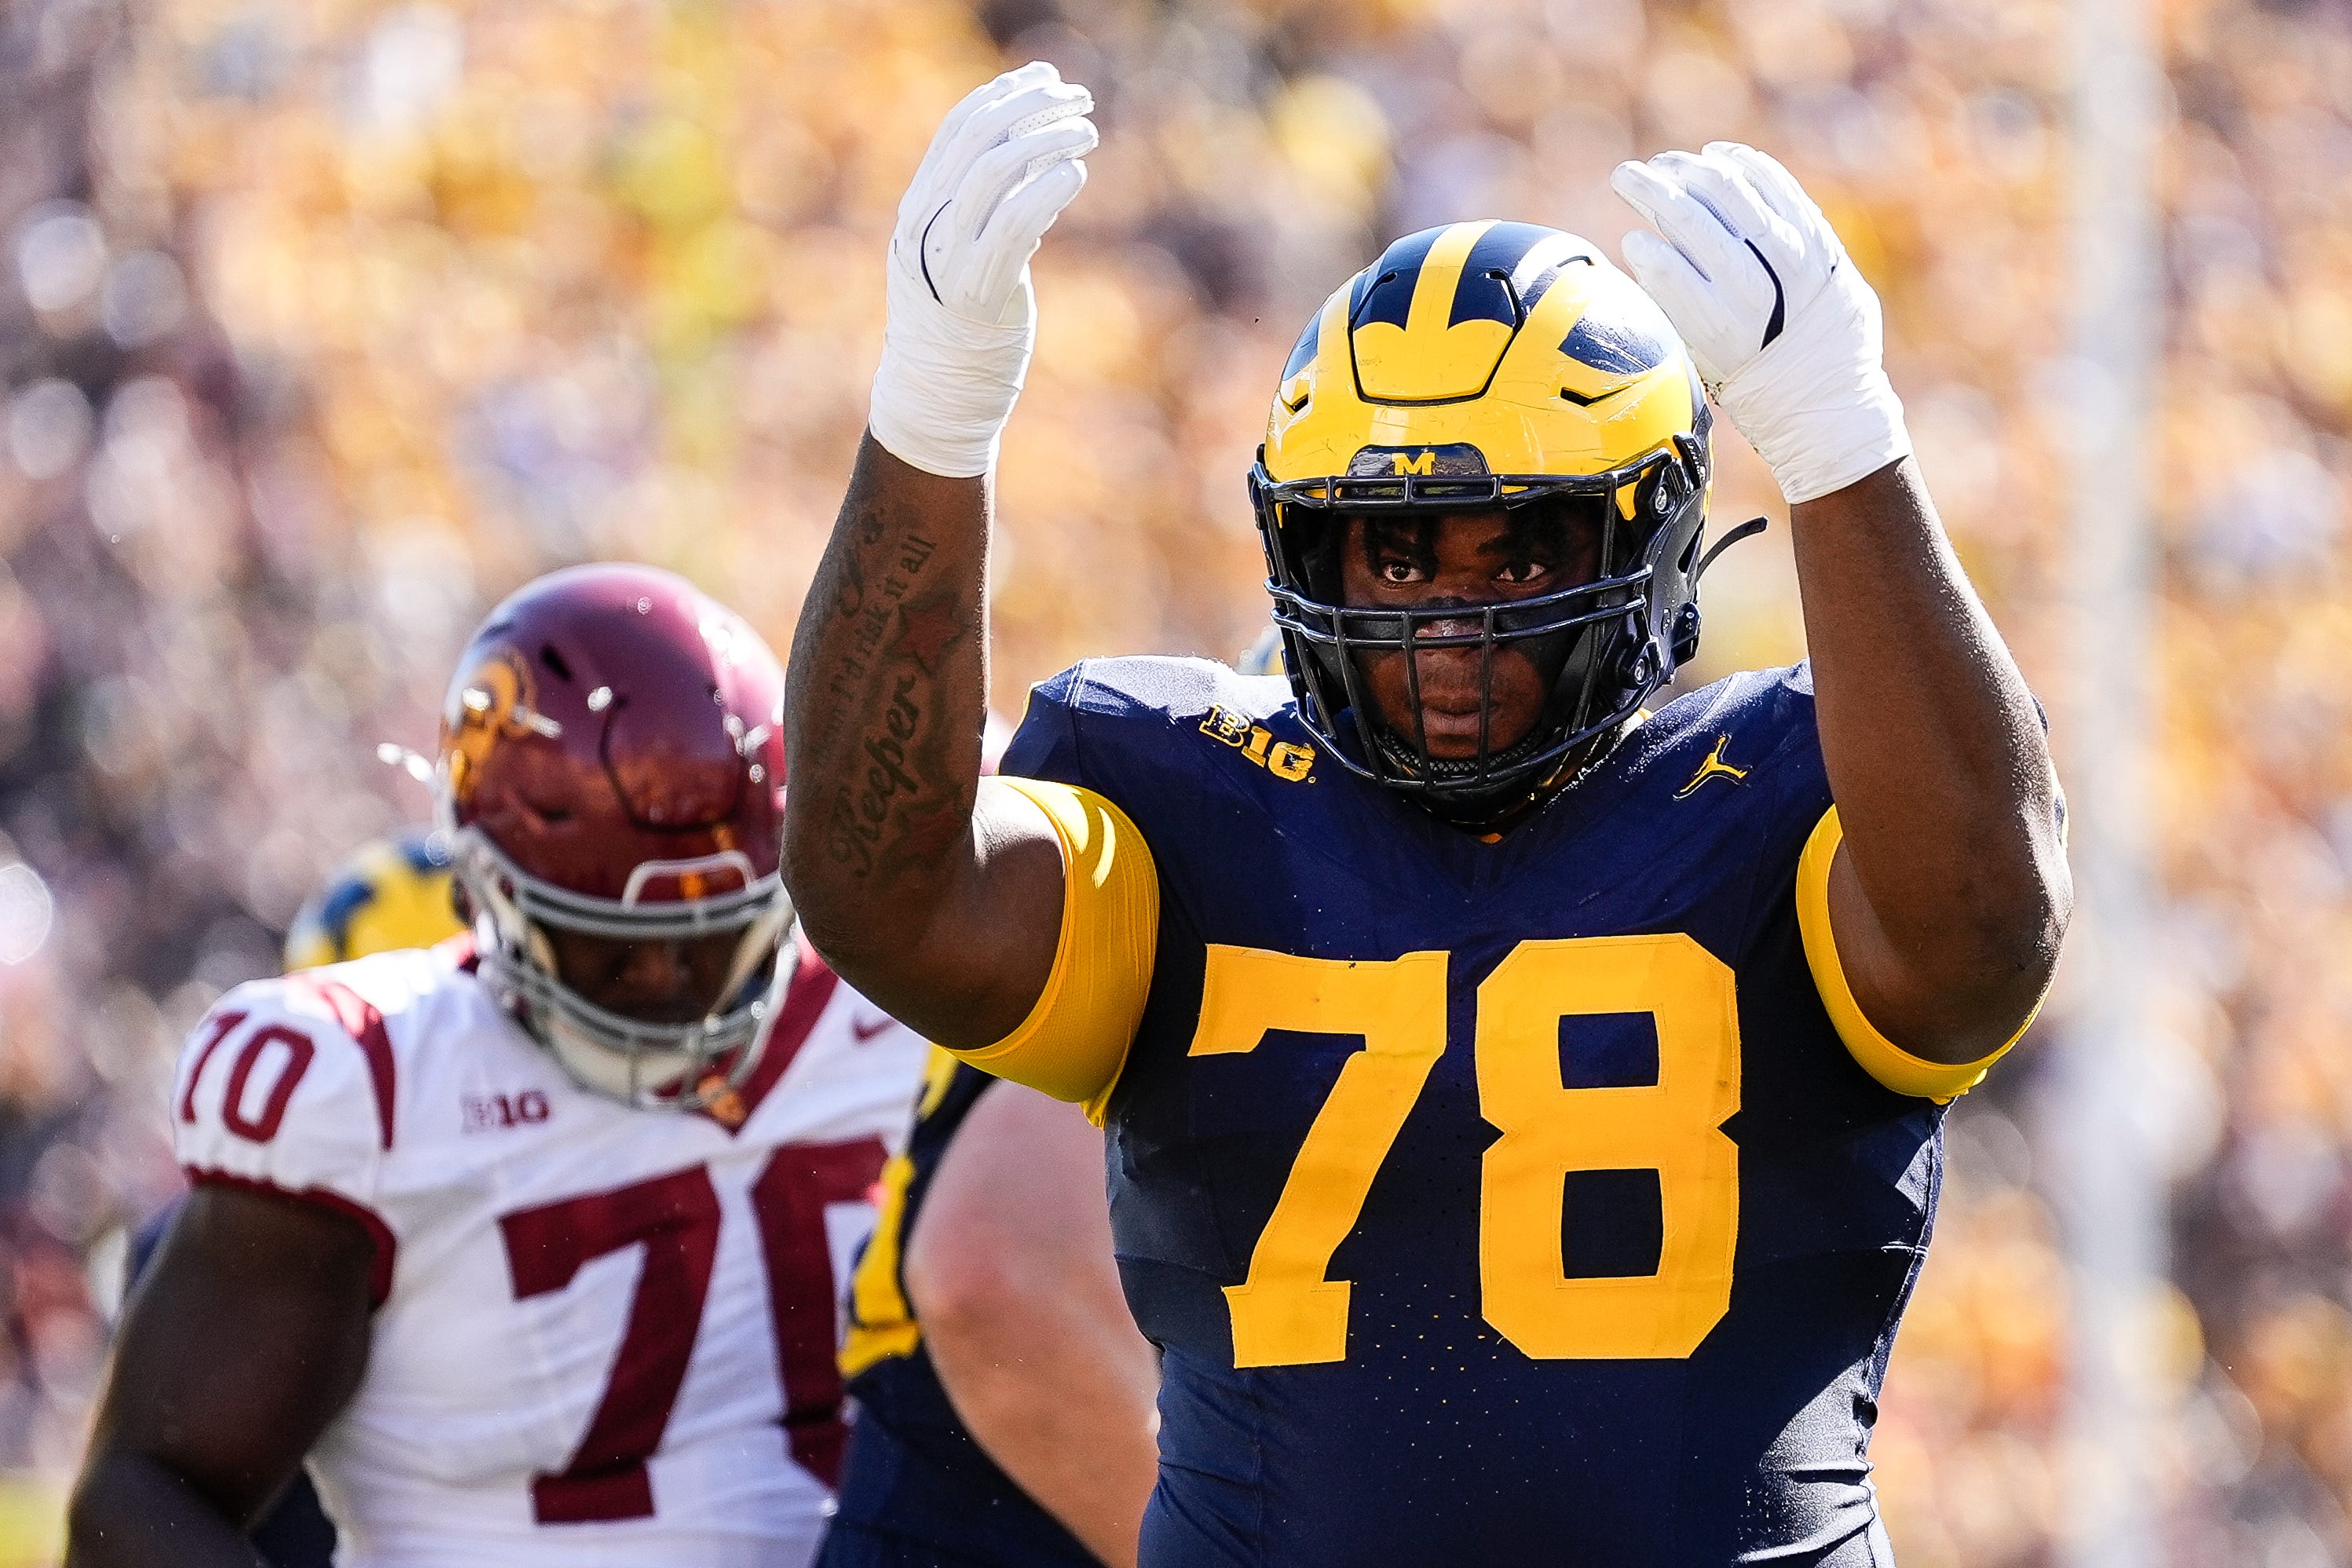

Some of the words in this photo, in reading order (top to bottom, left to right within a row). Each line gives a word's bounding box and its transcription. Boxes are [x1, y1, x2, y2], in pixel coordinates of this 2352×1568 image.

[1392, 452, 1436, 476] M
[876, 576, 909, 600] it
[901, 535, 937, 574] all
[829, 674, 920, 879] Keeper
[180, 1010, 315, 1145] 70
[1187, 933, 1741, 1369] 78
